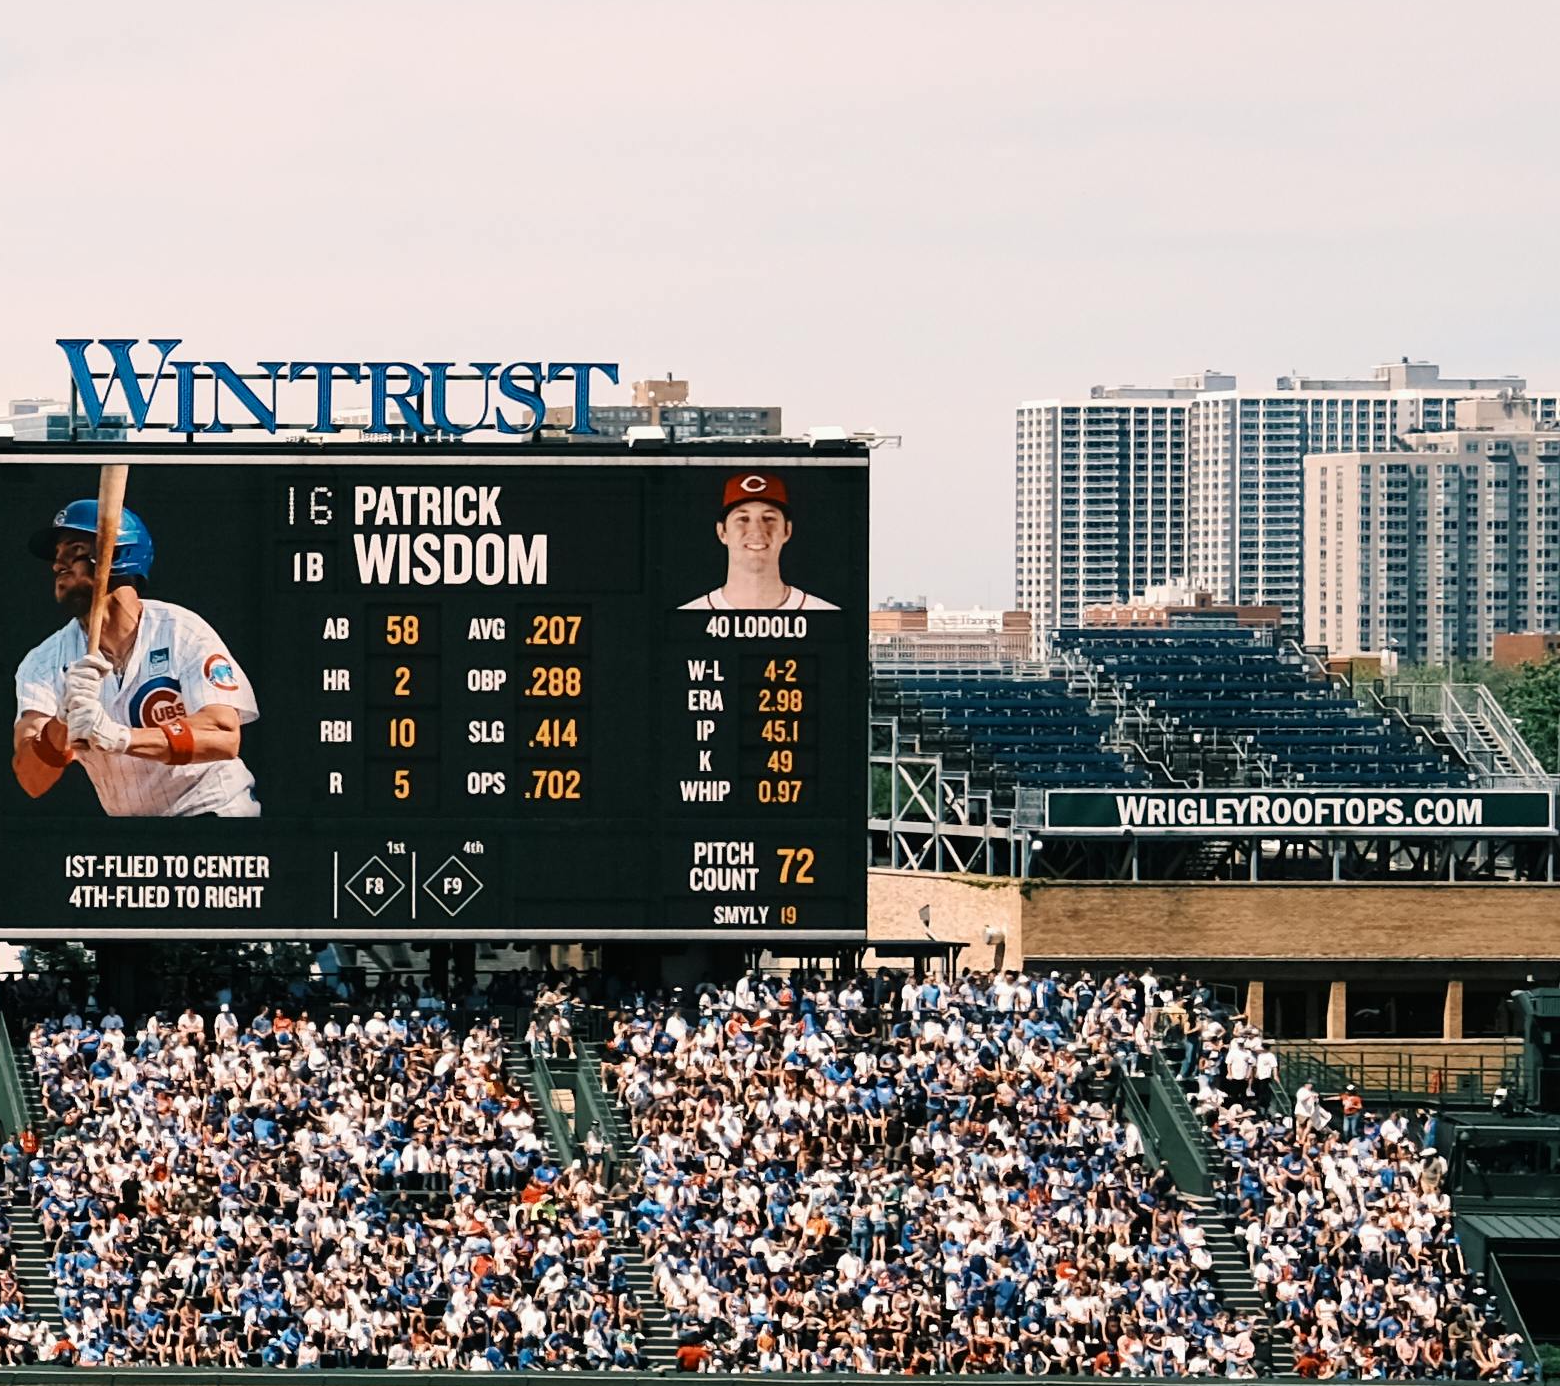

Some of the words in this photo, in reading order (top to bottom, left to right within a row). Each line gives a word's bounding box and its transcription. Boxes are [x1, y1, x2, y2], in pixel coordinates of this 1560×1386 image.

[56, 338, 619, 435] WINTRUST
[288, 486, 333, 525] 16
[354, 485, 502, 527] PATRICK
[293, 552, 324, 582] 1B
[353, 532, 548, 586] WISDOM
[322, 617, 350, 641] AB
[386, 616, 419, 645] 58
[467, 617, 506, 641] AVG
[525, 616, 582, 645] .207
[705, 615, 730, 638] 40
[734, 615, 808, 639] LODOLO
[322, 668, 351, 692] HR
[394, 666, 411, 697] 2
[467, 668, 507, 692] OBP
[524, 666, 582, 697] .288
[687, 659, 725, 682] W-L
[764, 659, 797, 682] 4-2
[687, 689, 724, 712] ERA
[758, 689, 803, 712] 2.98
[320, 720, 352, 743] RBI
[389, 717, 416, 748] 10
[468, 720, 505, 744] SLG
[528, 717, 578, 748] .414
[696, 719, 715, 742] IP
[761, 719, 799, 742] 45.1
[699, 750, 713, 773] K
[767, 750, 793, 773] 49
[329, 771, 343, 795] R
[394, 769, 410, 800] 5
[467, 771, 506, 795] OPS
[524, 769, 582, 800] .702
[679, 780, 731, 803] WHIP
[758, 780, 803, 803] 0.97
[386, 841, 406, 855] 1st
[462, 841, 485, 855] 4th
[65, 855, 159, 879] 1ST-FLIED
[163, 855, 187, 879] TO
[193, 855, 270, 879] CENTER
[693, 841, 755, 865] PITCH
[776, 847, 815, 884] 72
[365, 877, 385, 896] F8
[443, 877, 463, 896] F9
[689, 867, 760, 891] COUNT
[69, 886, 170, 909] 4TH-FLIED
[174, 886, 199, 909] TO
[205, 886, 265, 910] RIGHT
[713, 905, 770, 925] SMYLY
[780, 905, 797, 925] 19
